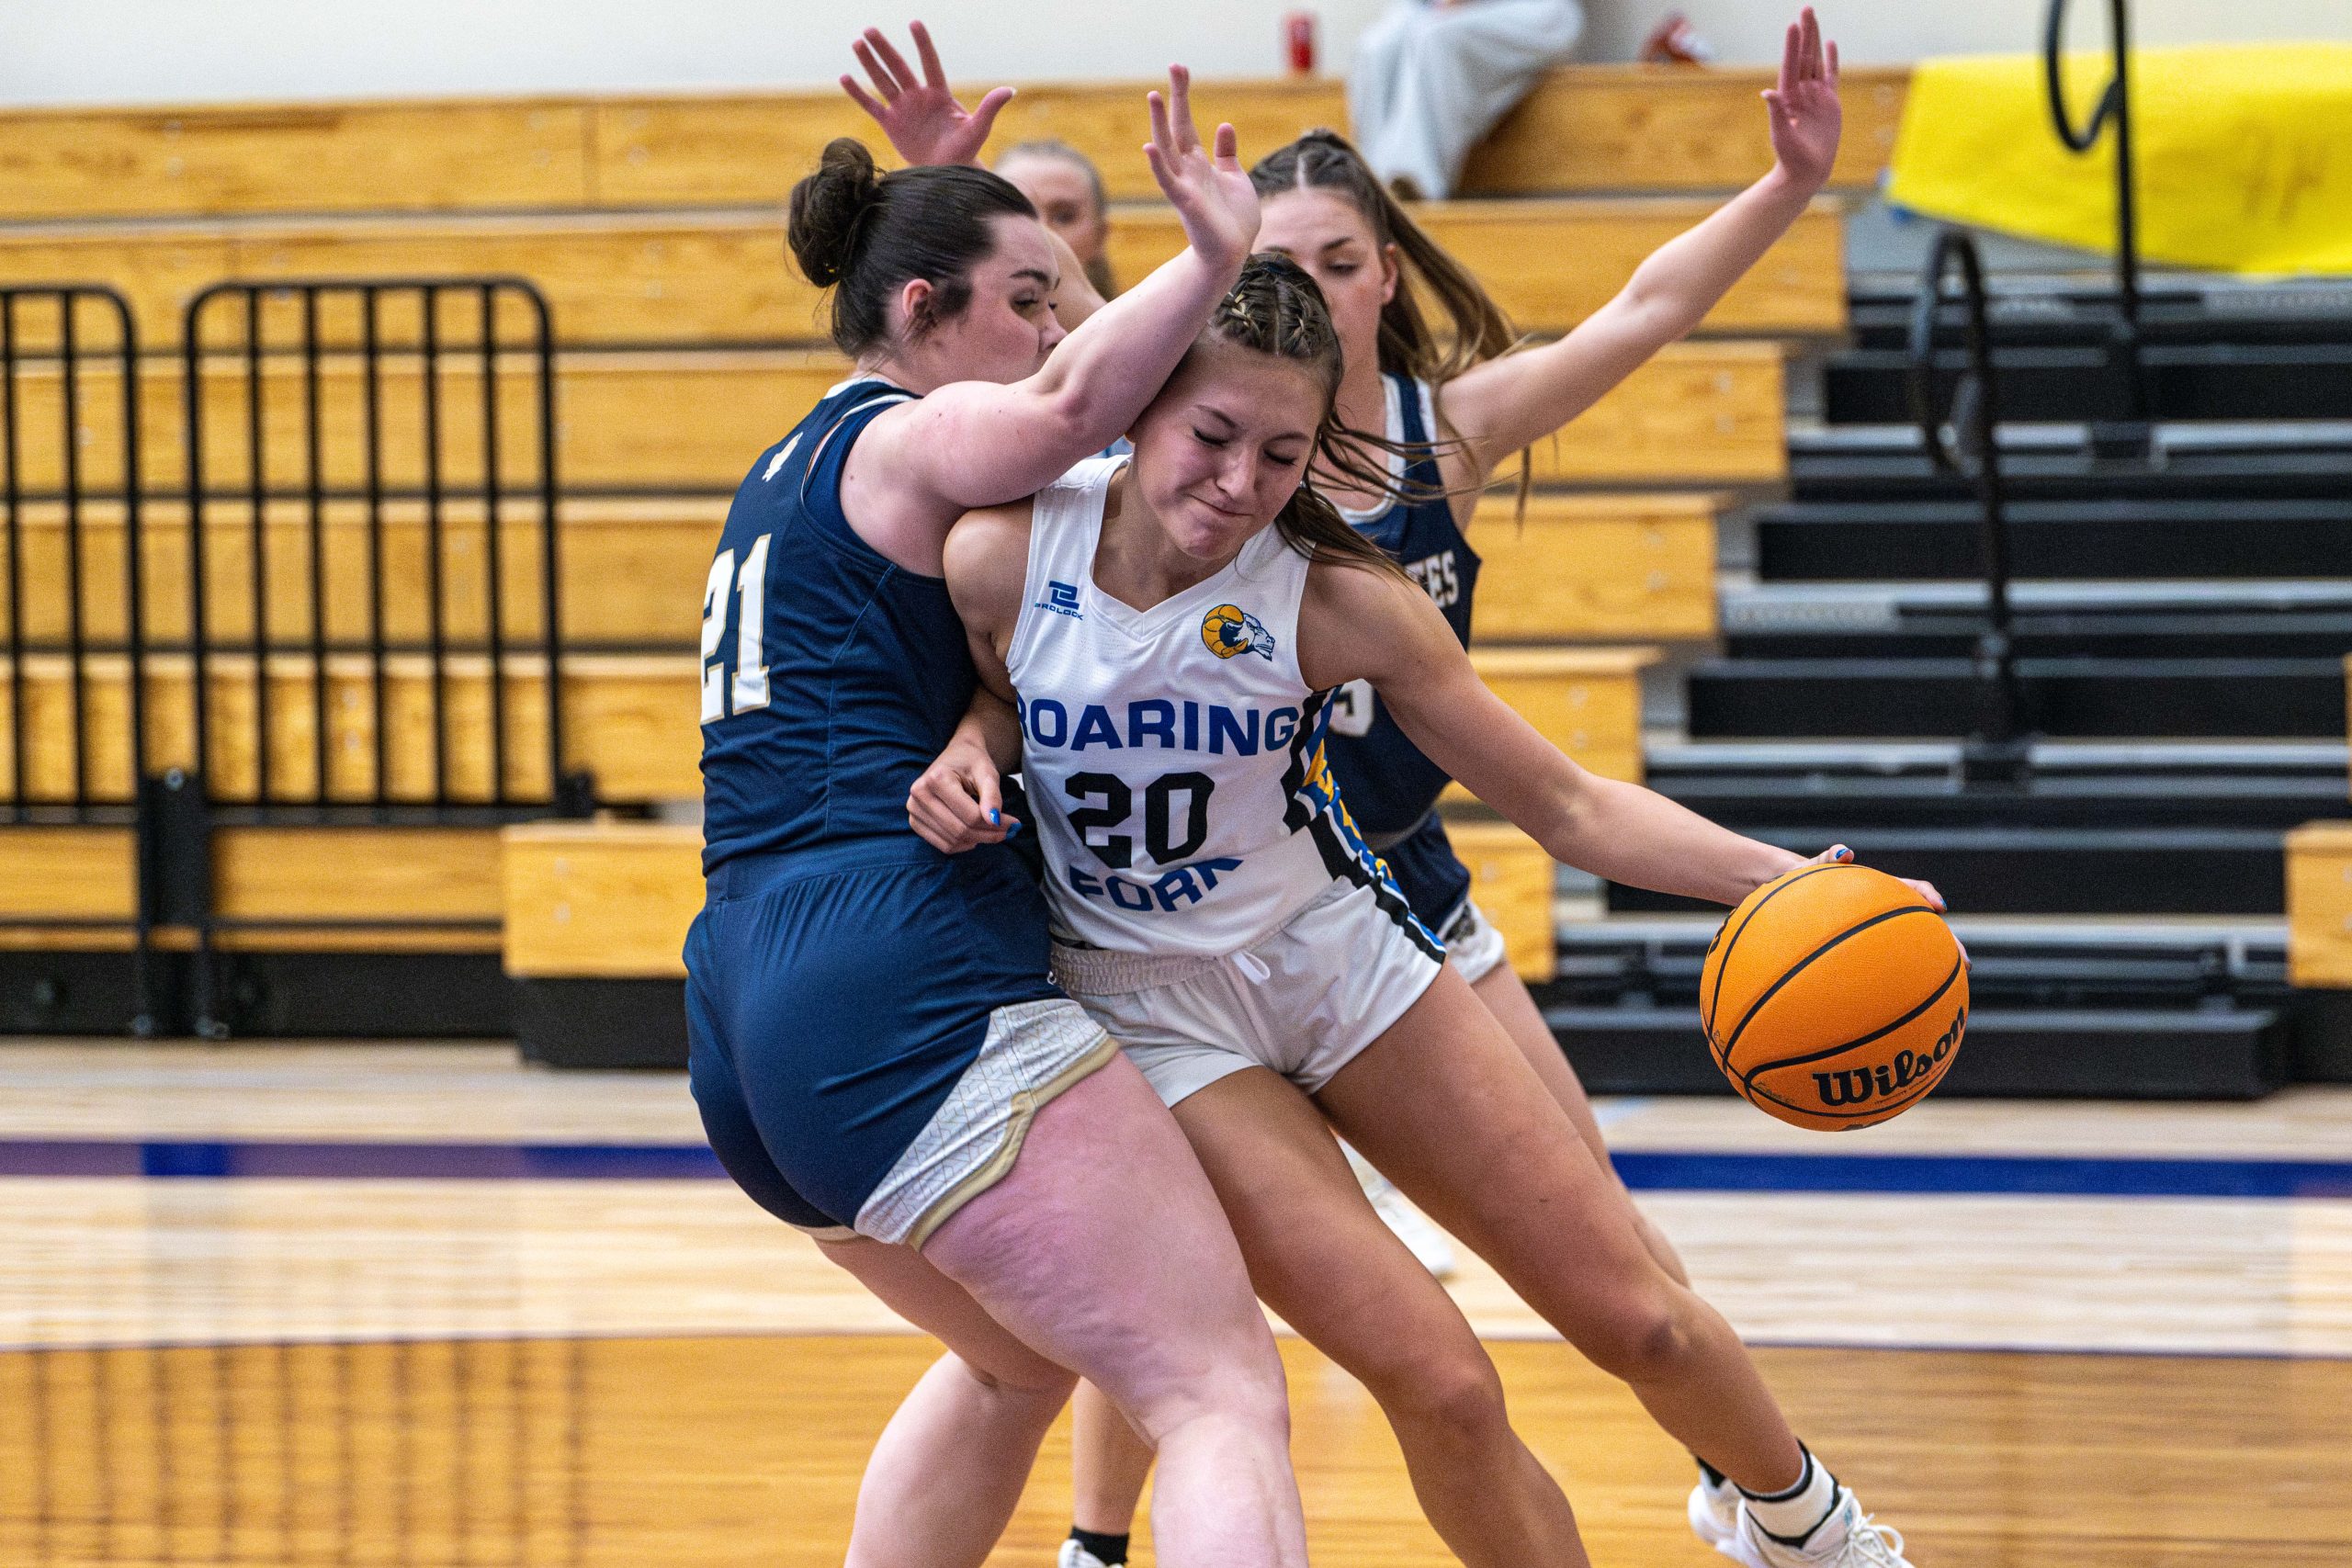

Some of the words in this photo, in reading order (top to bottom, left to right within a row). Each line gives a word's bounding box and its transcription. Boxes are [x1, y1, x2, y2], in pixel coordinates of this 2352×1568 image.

[700, 533, 773, 726] 21
[1065, 771, 1216, 869] 20
[1812, 1006, 1965, 1107] Wilson
